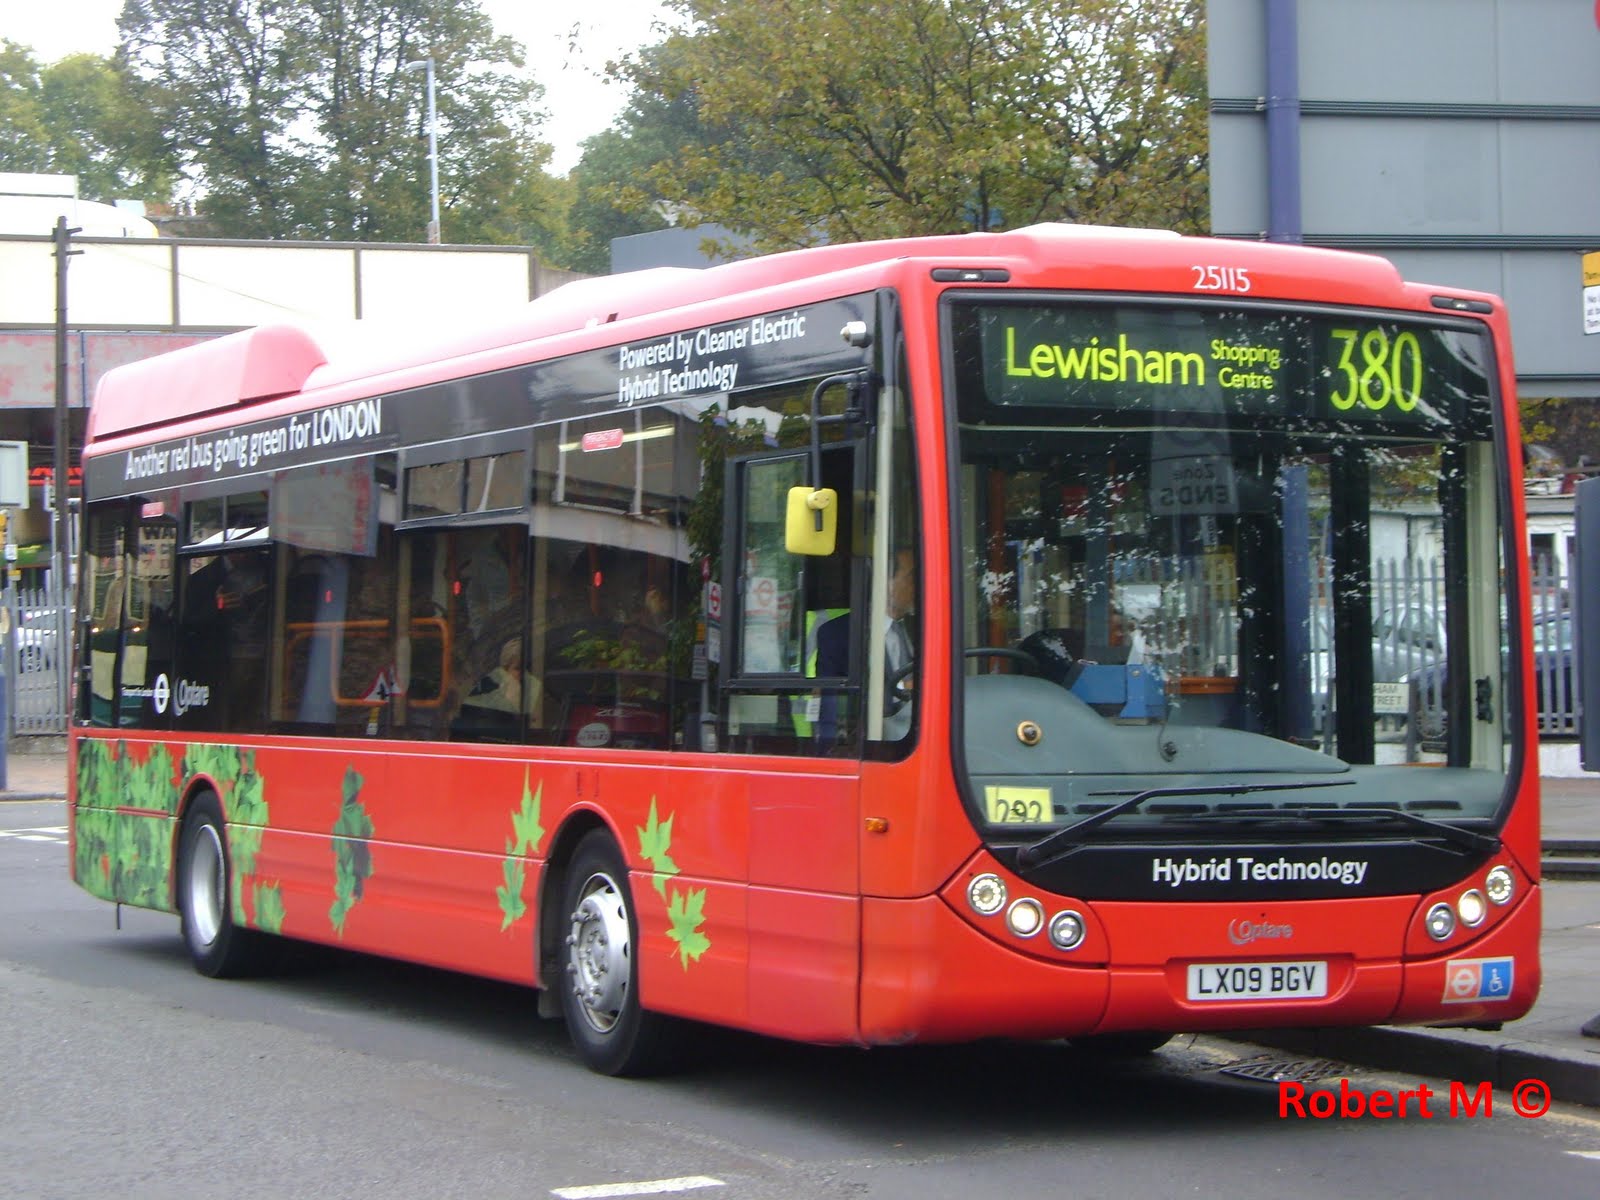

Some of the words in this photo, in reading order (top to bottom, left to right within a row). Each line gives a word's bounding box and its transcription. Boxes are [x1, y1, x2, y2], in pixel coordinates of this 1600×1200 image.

[1192, 266, 1251, 292] 25115
[619, 340, 675, 371] Powered
[676, 334, 694, 364] by
[695, 327, 749, 356] Cleaner
[751, 312, 806, 346] Electric
[1211, 339, 1280, 369] Shopping
[618, 371, 660, 407] Hybrid
[662, 361, 738, 391] Technology
[1006, 327, 1205, 386] Lewisham
[1330, 328, 1422, 411] 380
[1218, 367, 1274, 389] Centre
[125, 446, 169, 480] Another
[170, 438, 190, 472] red
[192, 437, 212, 468] bus
[213, 430, 248, 472] going
[249, 428, 287, 467] green
[289, 416, 311, 450] for
[312, 398, 382, 446] LONDON
[1152, 858, 1231, 887] Hybrid
[1237, 857, 1368, 884] Technology
[1238, 919, 1293, 942] Optare
[1198, 967, 1262, 994] LX09
[1271, 965, 1316, 992] BGV
